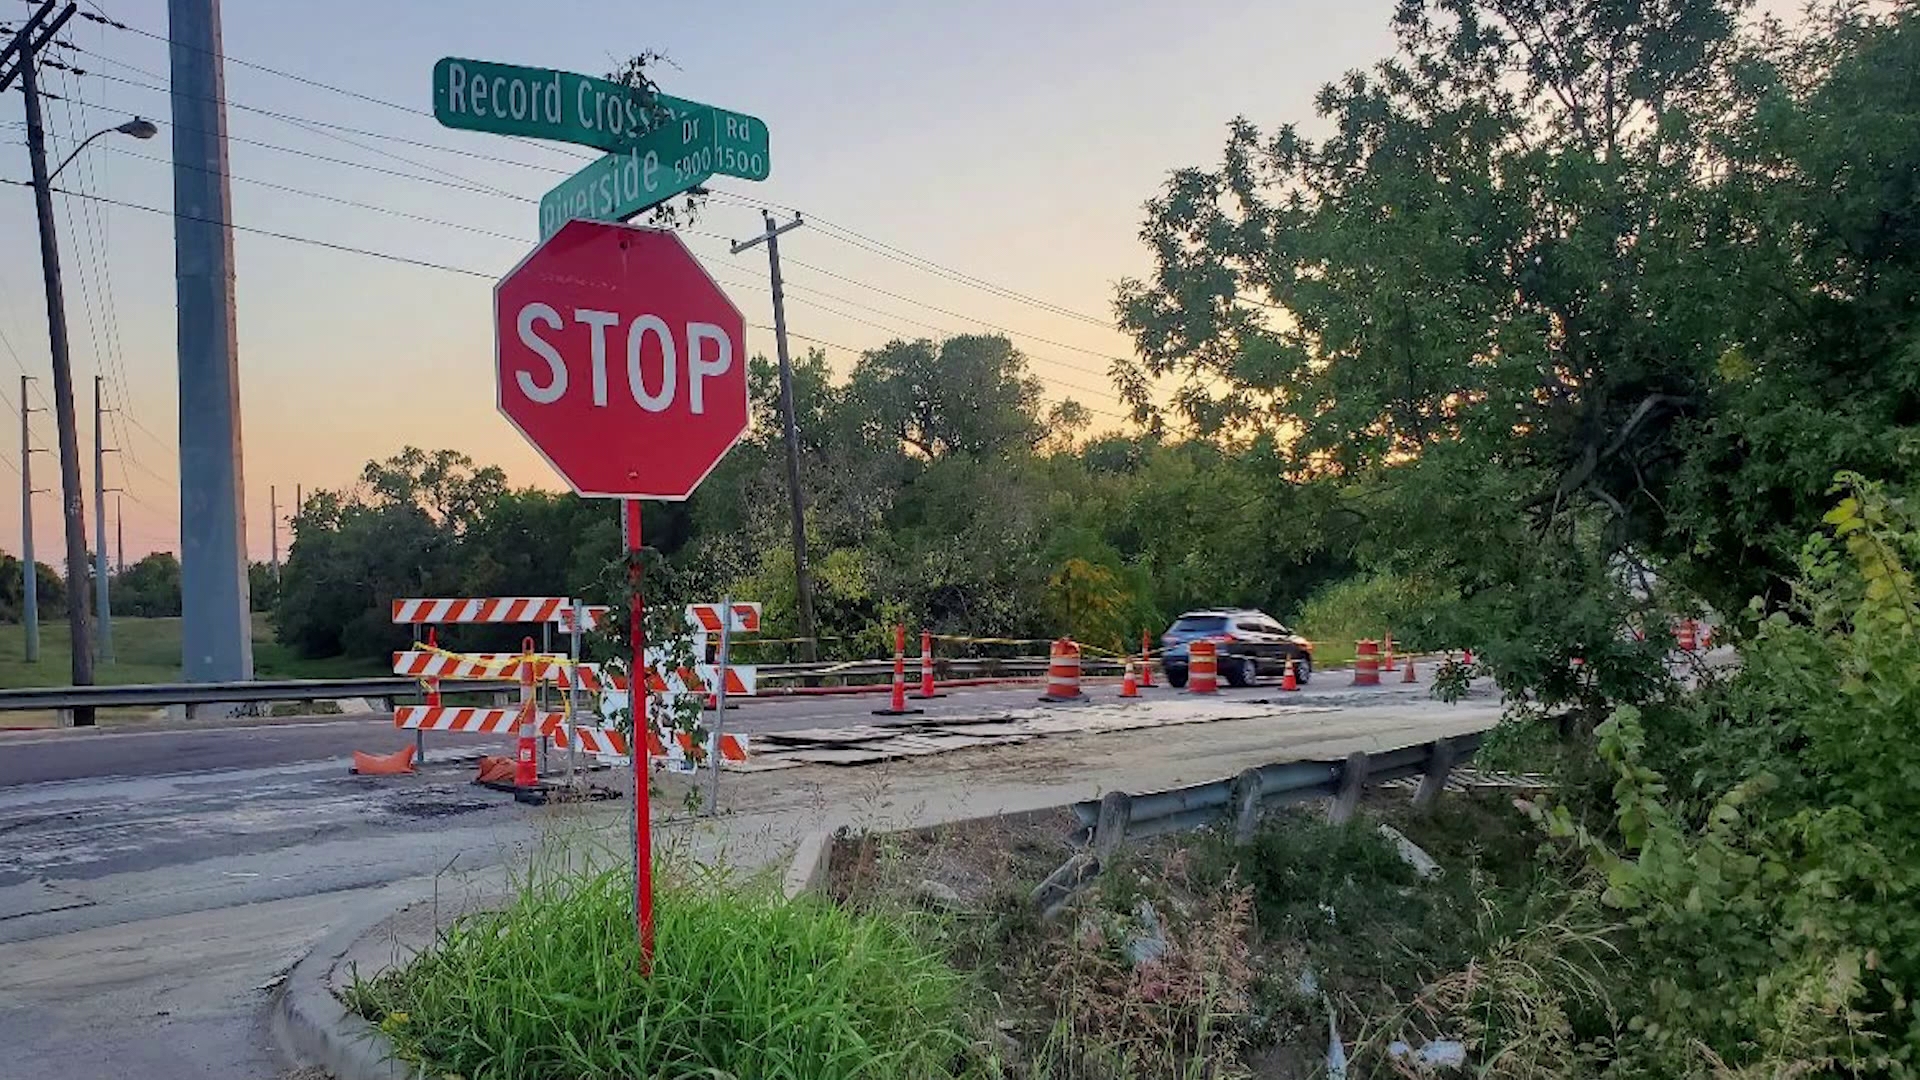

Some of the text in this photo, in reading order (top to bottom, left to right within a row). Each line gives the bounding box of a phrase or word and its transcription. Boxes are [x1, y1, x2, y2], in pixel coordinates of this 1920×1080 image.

[449, 62, 562, 124] Record
[726, 116, 750, 142] Rd
[682, 118, 700, 145] Dr
[674, 146, 712, 184] 5900
[716, 145, 763, 176] 1500
[514, 302, 733, 414] STOP
